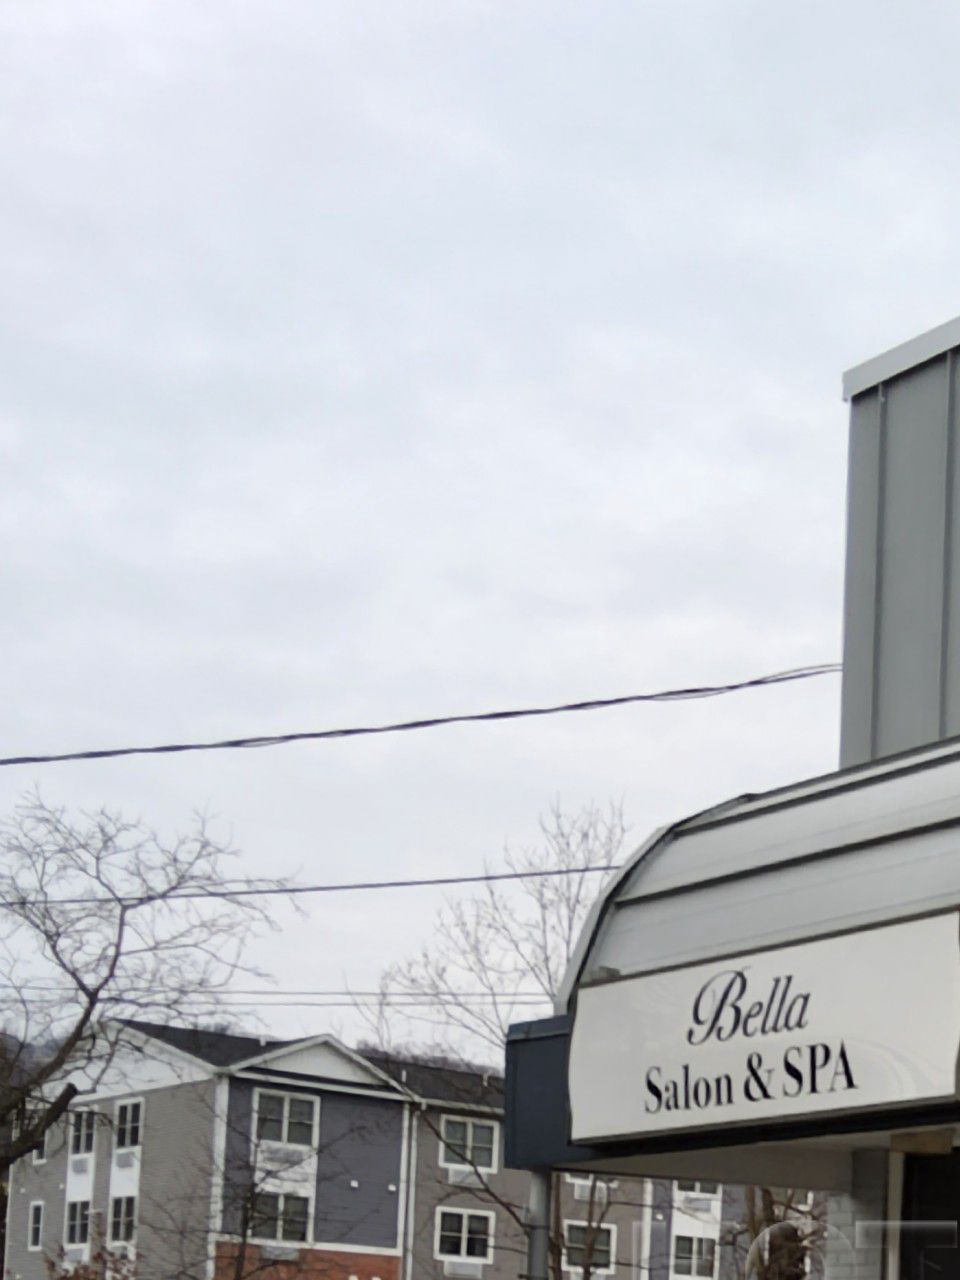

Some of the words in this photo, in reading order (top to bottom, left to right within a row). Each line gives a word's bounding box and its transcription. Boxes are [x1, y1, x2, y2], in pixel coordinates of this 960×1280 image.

[687, 966, 811, 1045] Bella
[645, 1065, 735, 1114] Salon
[743, 1051, 775, 1102] &
[782, 1039, 858, 1099] SPA
